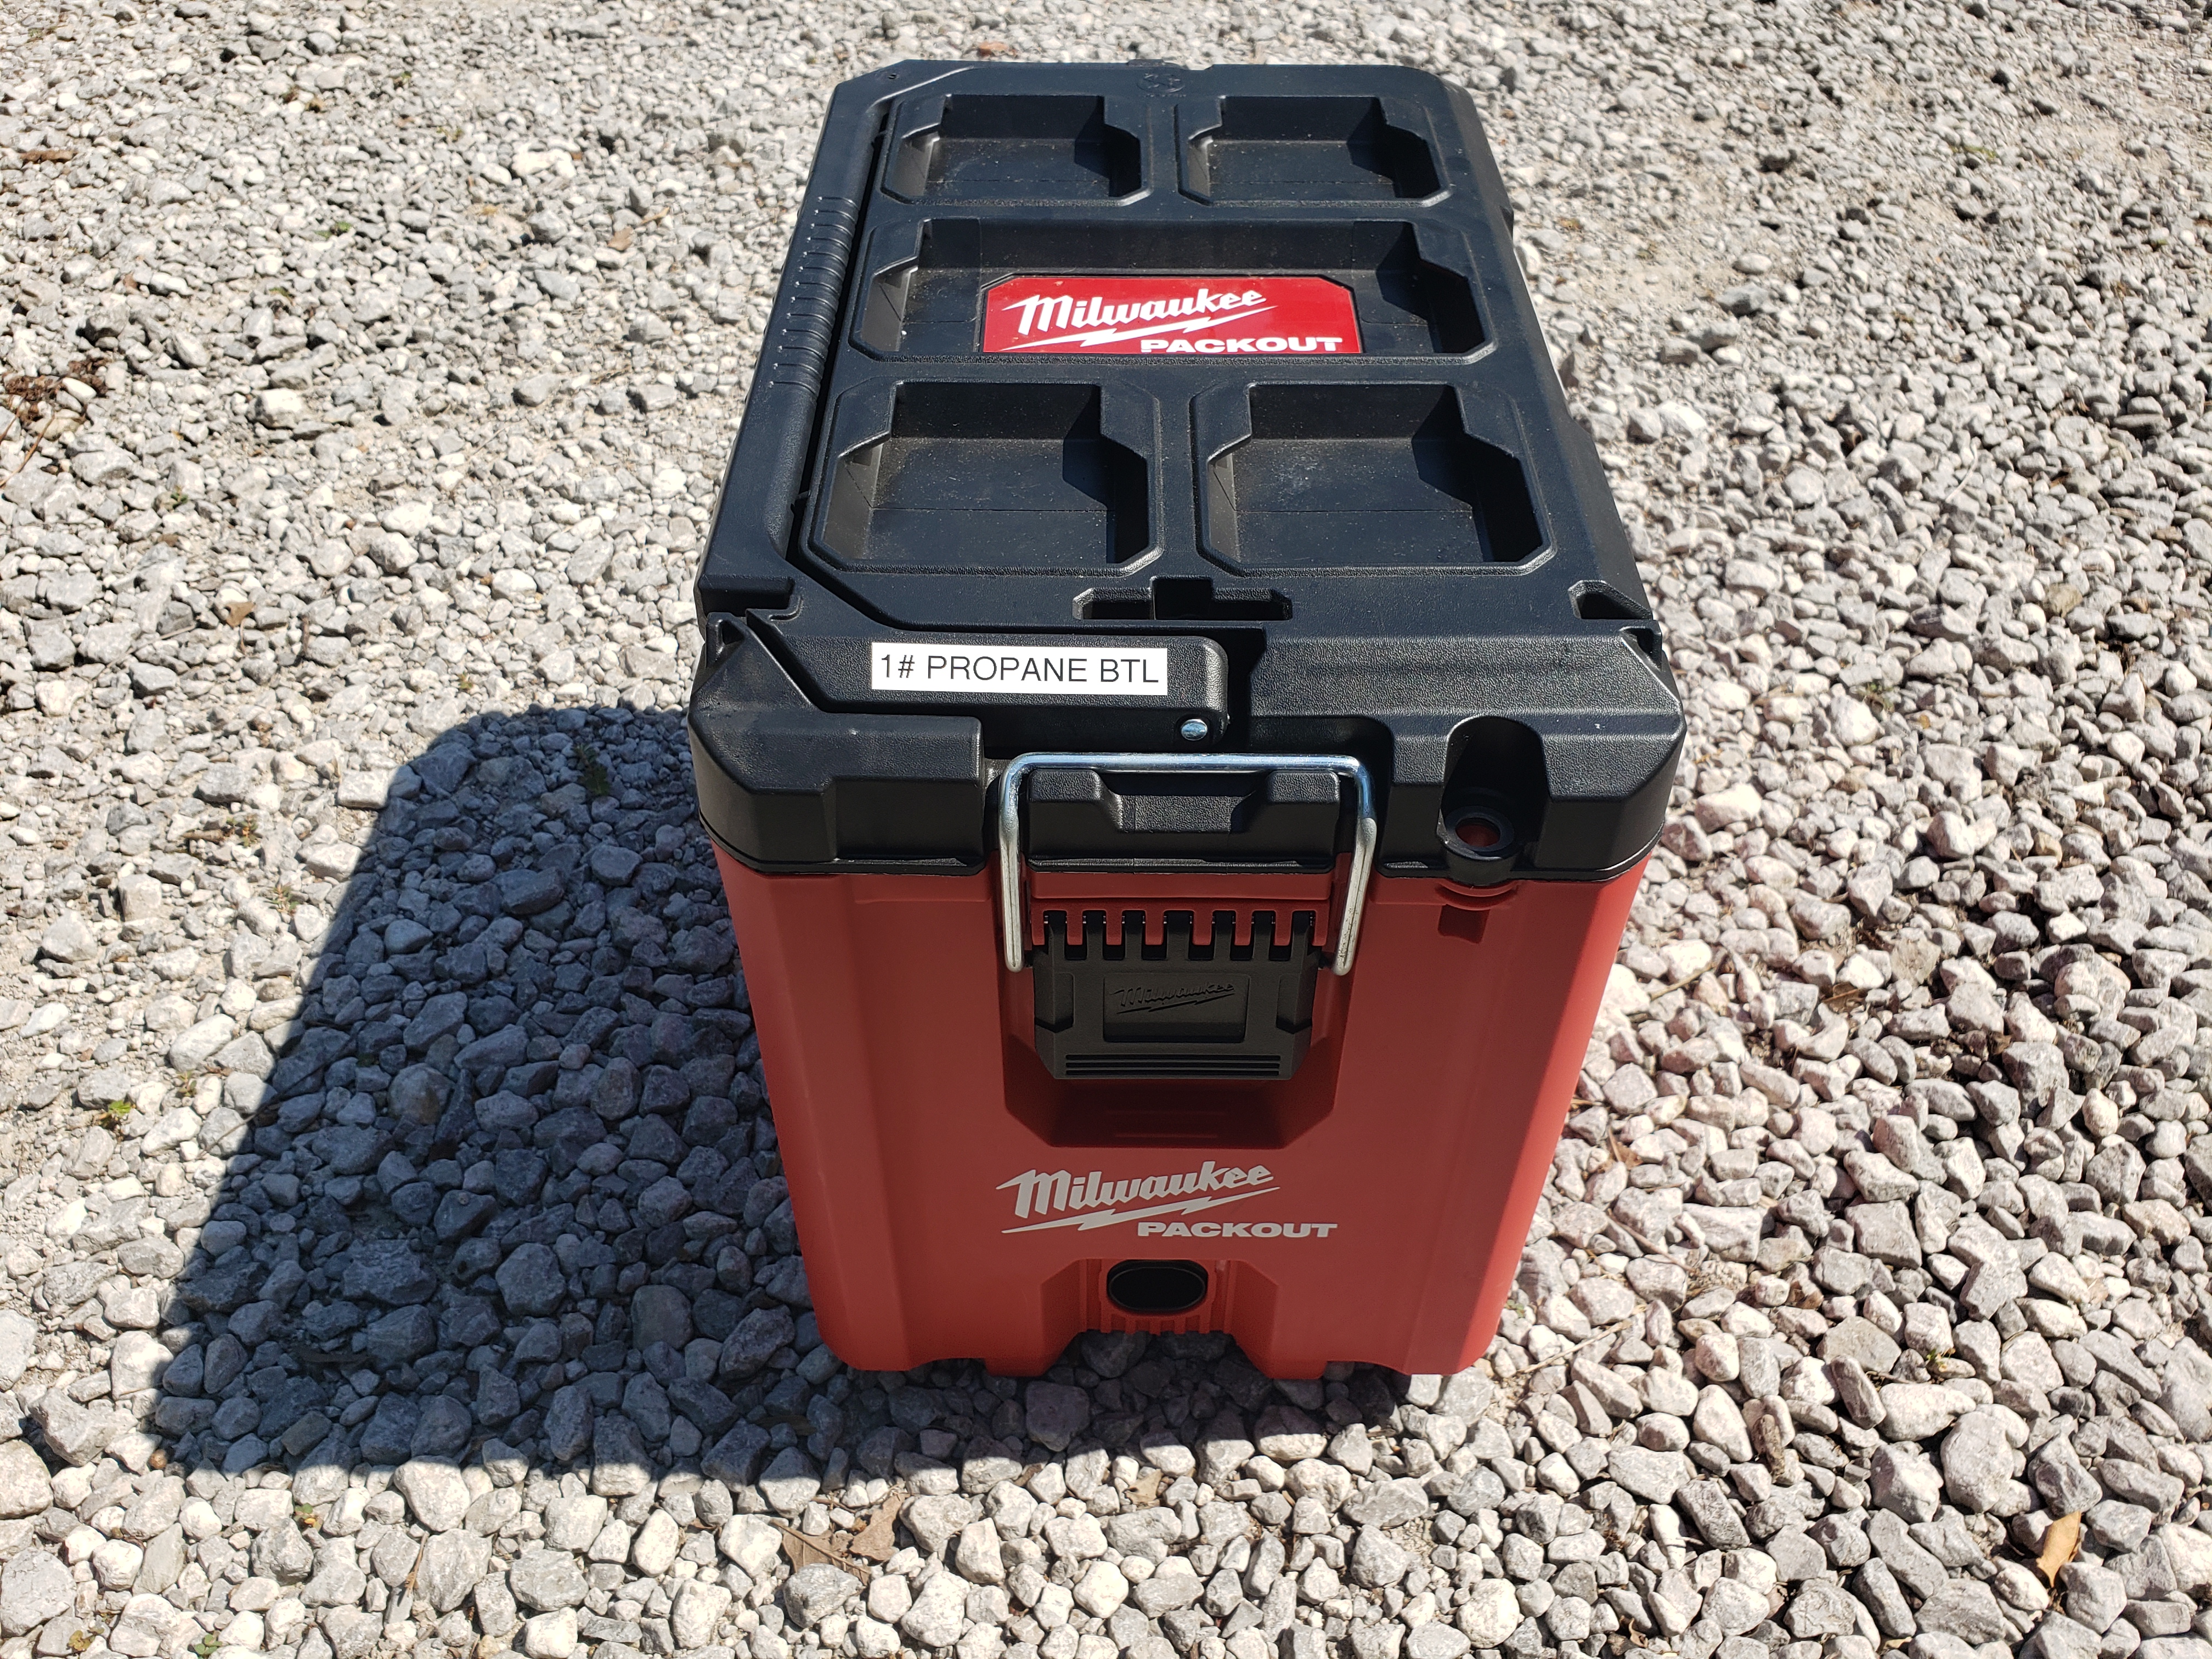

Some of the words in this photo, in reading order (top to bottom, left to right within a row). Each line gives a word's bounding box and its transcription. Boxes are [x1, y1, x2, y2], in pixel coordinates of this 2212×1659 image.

[1002, 288, 1267, 335] Milwaukee
[1141, 337, 1342, 353] PACKOUT
[881, 654, 916, 678] 1#
[928, 656, 1088, 682] PROPANE
[1100, 659, 1159, 682] BTL
[1110, 983, 1235, 1006] Milwaukee
[996, 1161, 1274, 1218] Milwaukee
[1137, 1222, 1338, 1237] PACKOUT
